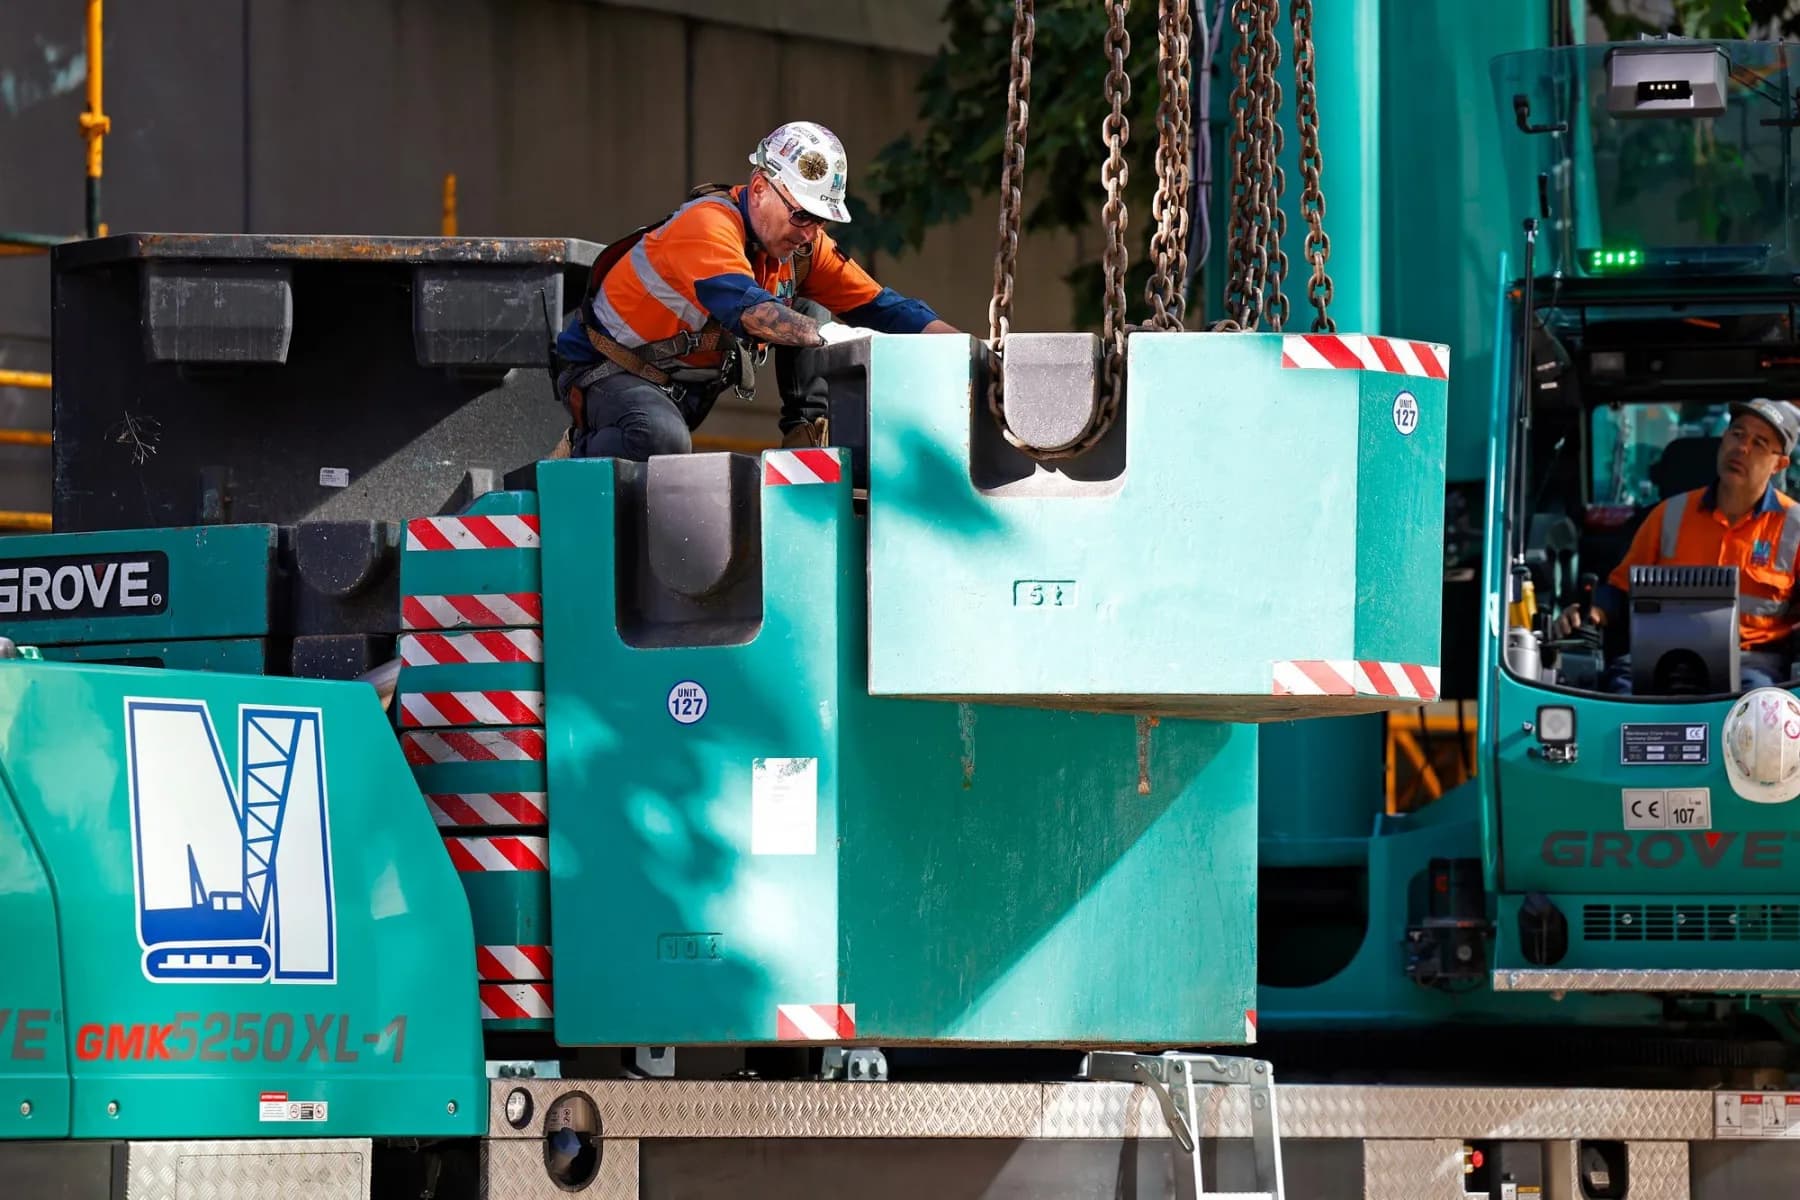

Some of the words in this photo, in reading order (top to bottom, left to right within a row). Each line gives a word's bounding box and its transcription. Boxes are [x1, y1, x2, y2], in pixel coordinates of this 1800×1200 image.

[1400, 399, 1412, 408] UNIT
[1396, 409, 1415, 427] 127
[0, 562, 150, 613] GROVE
[677, 688, 698, 697] UNIT
[672, 698, 703, 715] 127
[1673, 808, 1695, 824] 107
[1541, 831, 1787, 869] GROVE
